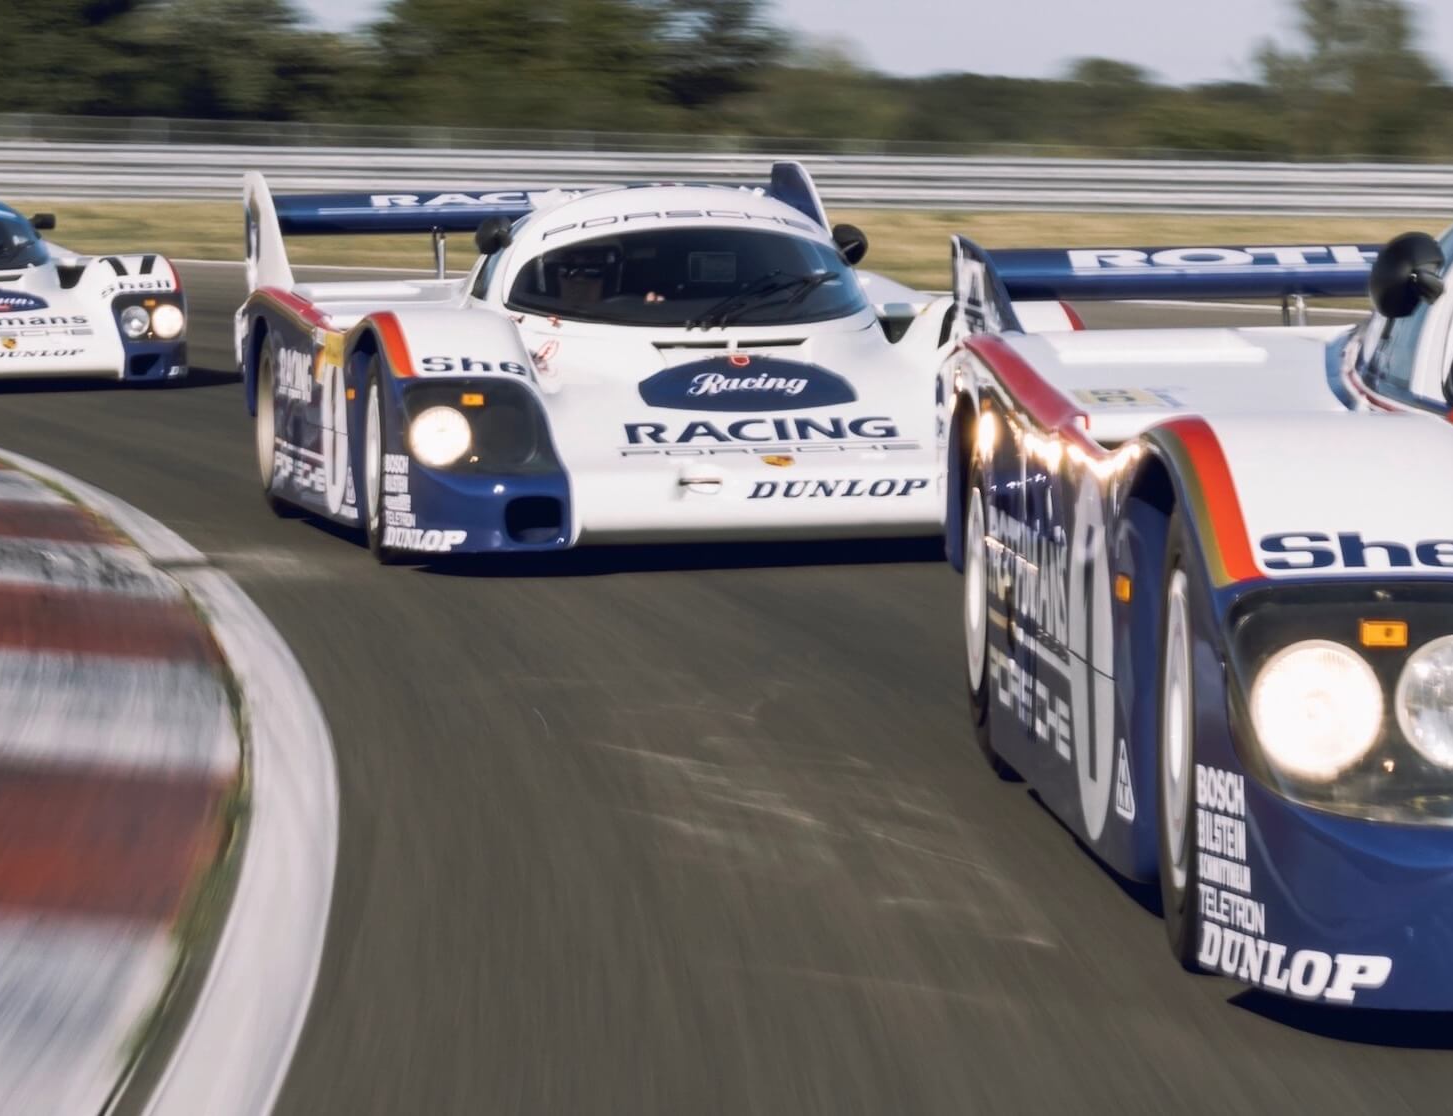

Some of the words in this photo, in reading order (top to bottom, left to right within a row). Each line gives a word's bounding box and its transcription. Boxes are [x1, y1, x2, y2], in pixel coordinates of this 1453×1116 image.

[542, 209, 817, 241] PORSCHE
[101, 280, 171, 298] Shell
[422, 356, 528, 376] She
[686, 372, 810, 396] Racing
[623, 417, 901, 444] RACING
[620, 444, 923, 457] PORSCHE
[747, 479, 932, 499] DUNLOP
[382, 526, 467, 552] DUNLOP
[1195, 763, 1245, 817] BOSCH
[1195, 808, 1247, 862] BILSTEIN
[1197, 882, 1265, 936] TELETRON
[1199, 920, 1393, 1005] DUNLOP
